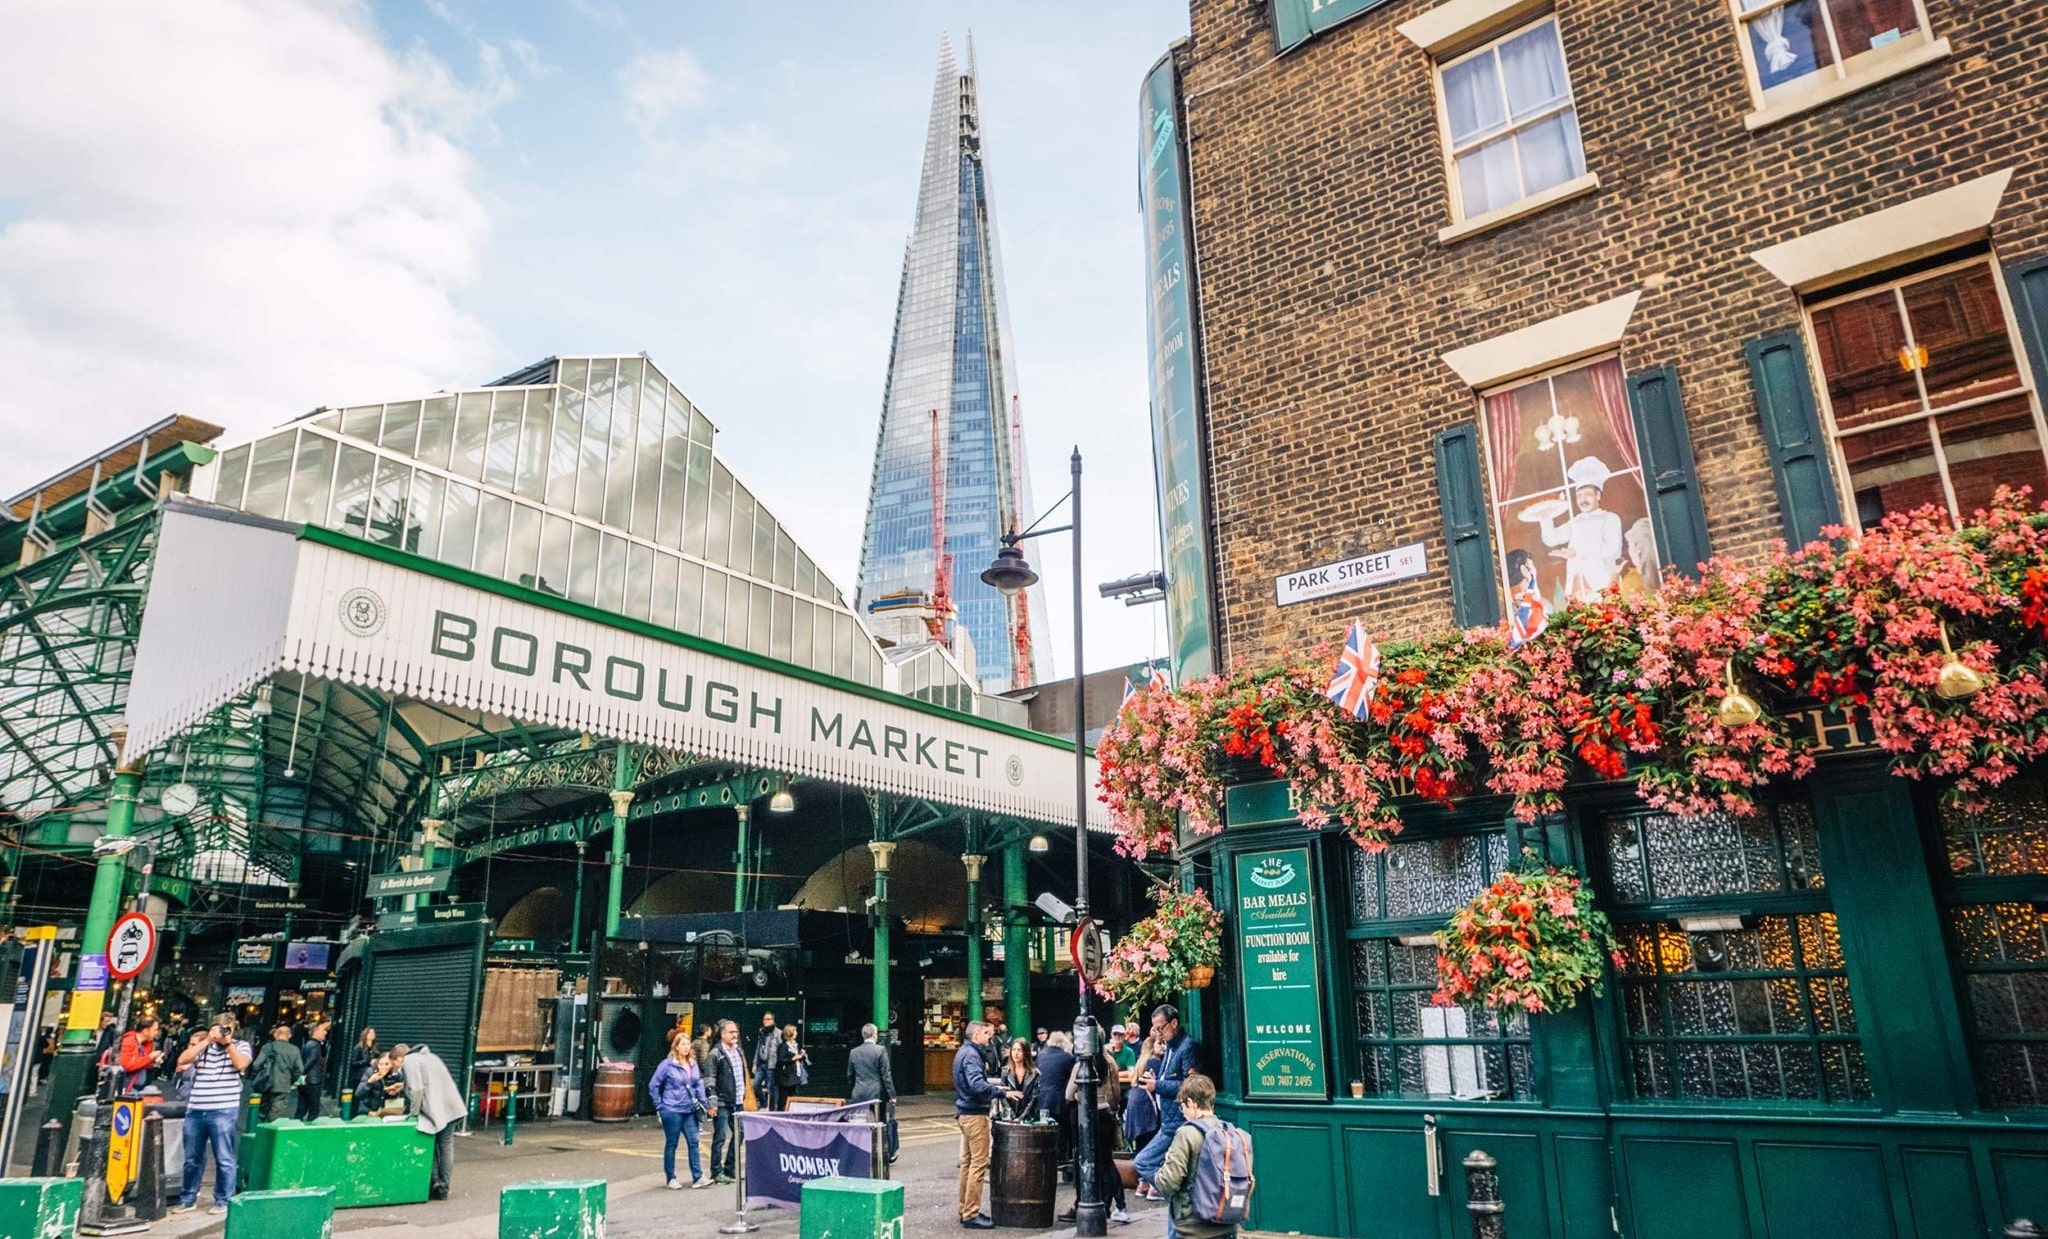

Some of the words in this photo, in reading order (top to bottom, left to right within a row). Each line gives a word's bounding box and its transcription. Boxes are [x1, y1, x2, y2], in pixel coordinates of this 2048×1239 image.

[1288, 569, 1330, 592] PARK
[1338, 554, 1392, 580] STREET
[1399, 555, 1413, 567] SE1
[1302, 587, 1326, 597] LONDON
[1326, 581, 1354, 594] BOROUGH
[1363, 571, 1396, 583] SOUTHWARK
[430, 609, 783, 734] BOROUGH
[811, 706, 989, 779] MARKET
[1261, 857, 1282, 869] THE
[1243, 895, 1266, 909] BAR
[1268, 892, 1307, 907] MEALS
[1250, 906, 1298, 921] Available
[1245, 932, 1285, 948] FUNCTION
[1286, 931, 1310, 946] ROOM
[1257, 949, 1288, 964] available
[1288, 948, 1299, 962] for
[1271, 967, 1287, 981] hire
[1255, 1024, 1312, 1035] WELCOME
[1255, 1047, 1317, 1071] RESERVATIONS
[1280, 1064, 1291, 1073] TEL
[1261, 1075, 1276, 1087] 020
[1277, 1075, 1294, 1087] 7407
[1295, 1075, 1313, 1087] 2495
[779, 1152, 818, 1176] DOOM
[815, 1157, 840, 1178] BAR
